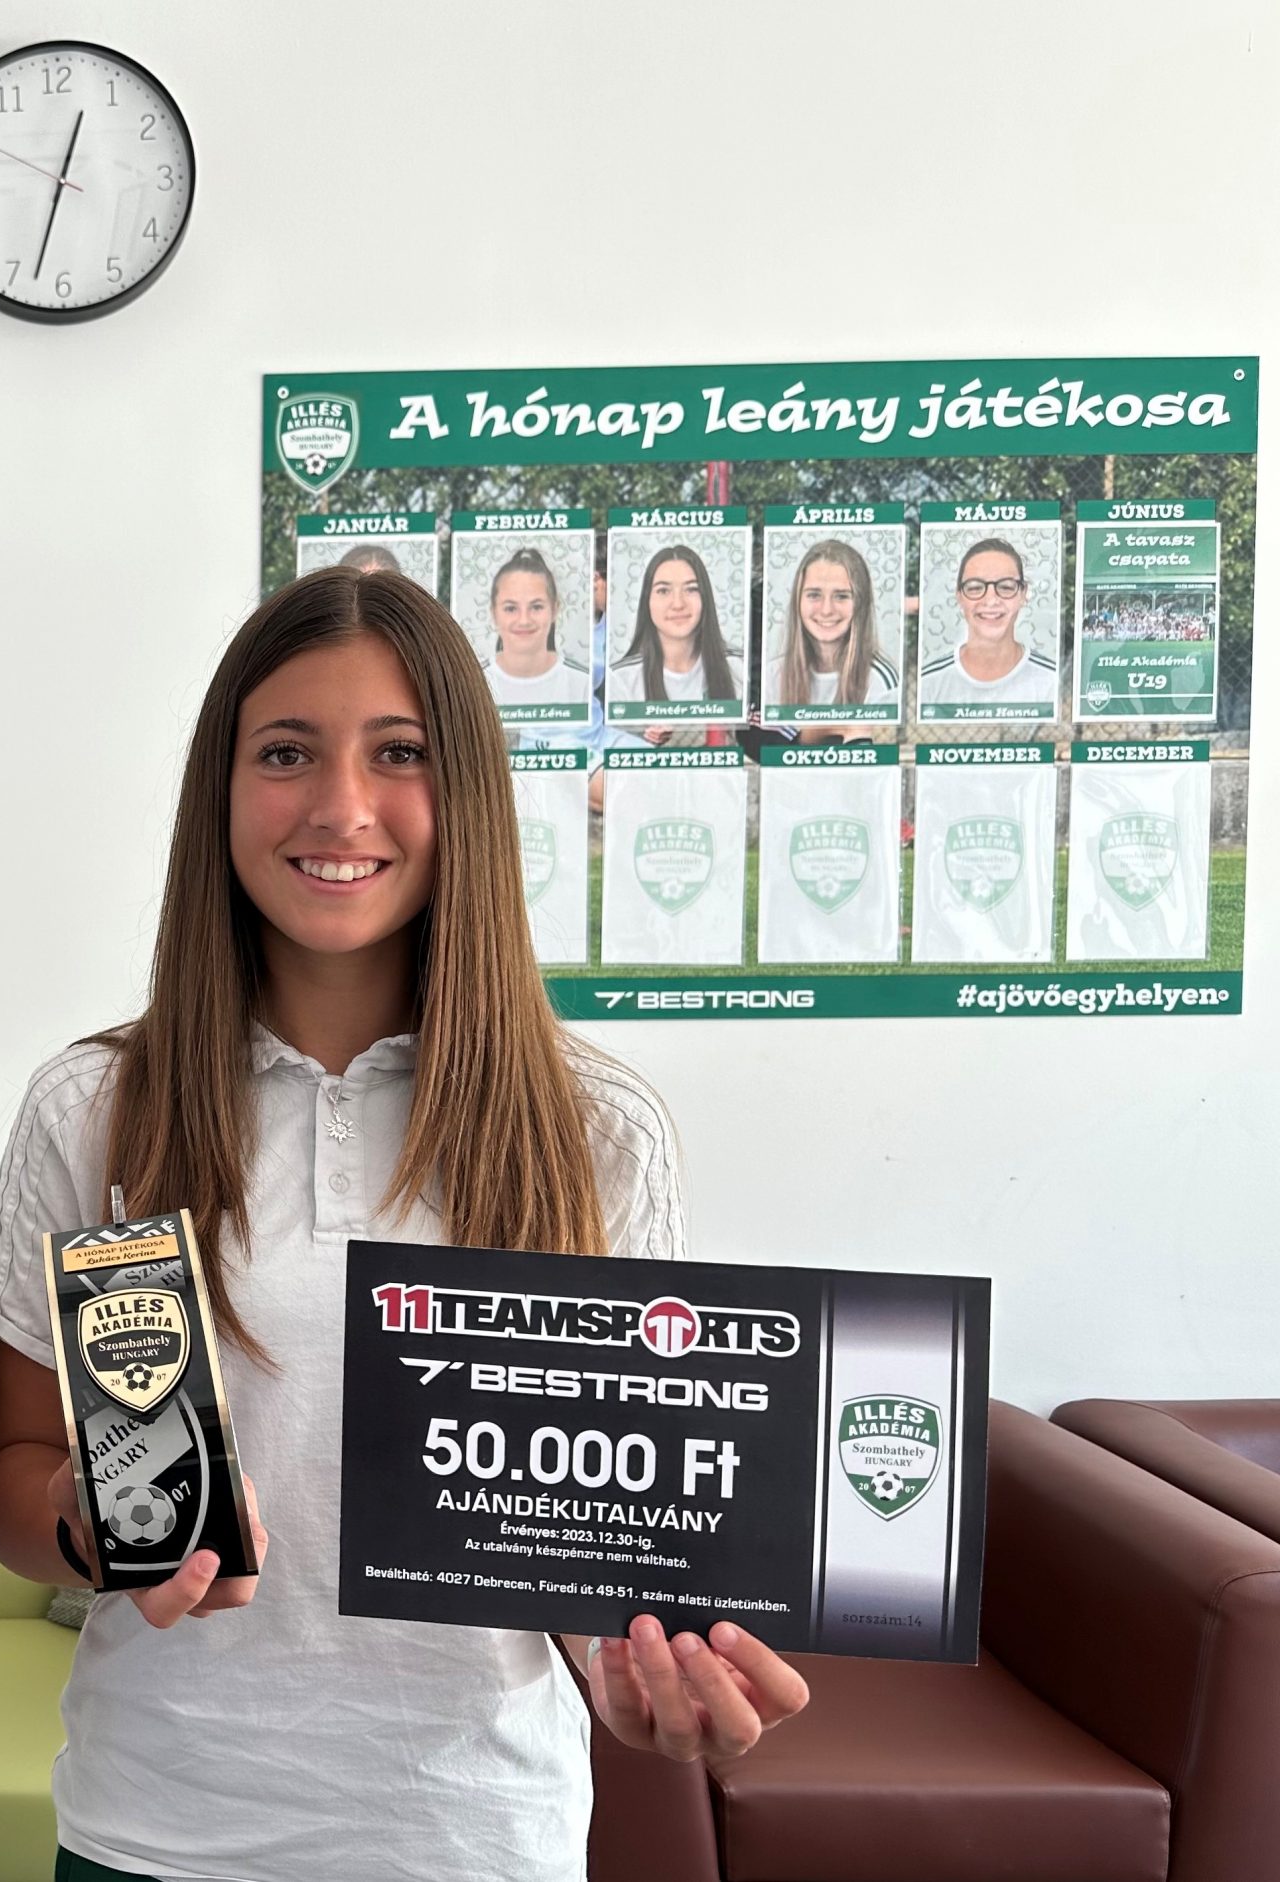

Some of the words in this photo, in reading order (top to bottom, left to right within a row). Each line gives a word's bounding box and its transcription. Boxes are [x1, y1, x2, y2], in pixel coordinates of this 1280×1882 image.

[41, 66, 72, 94] 12
[107, 80, 118, 107] 1
[140, 114, 157, 141] 2
[157, 165, 175, 192] 3
[142, 217, 160, 243] 4
[6, 261, 21, 286] 7
[107, 257, 122, 283] 5
[55, 272, 72, 298] 6
[291, 402, 343, 419] ILLÉS
[389, 395, 449, 440] A
[466, 386, 685, 450] hónap
[702, 380, 900, 444] leány
[909, 377, 1231, 438] játékosa
[631, 509, 725, 527] MÁRCIUS
[793, 506, 875, 524] ÁPRILIS
[954, 504, 1027, 522] MÁJUS
[1107, 501, 1185, 520] JÚNIUS
[323, 516, 409, 534] JANUÁR
[475, 512, 568, 530] FEBRUÁR
[1102, 533, 1122, 547] A
[1124, 533, 1196, 548] tavasz
[1108, 551, 1191, 569] csapata
[1131, 656, 1197, 667] Akadémia
[1128, 673, 1167, 689] U19
[645, 705, 688, 715] Pintér
[690, 704, 725, 715] Tekla
[608, 751, 739, 767] SZEPTEMBER
[782, 746, 877, 765] OKTÓBER
[929, 747, 1041, 763] NOVEMBER
[1087, 746, 1194, 761] DECEMBER
[637, 990, 815, 1009] BESTRONG
[956, 982, 1218, 1015] #ajövőegyhelyen
[84, 1247, 117, 1257] HÓNAP
[119, 1240, 165, 1252] JÁTÉKOSA
[95, 1296, 164, 1321] ILLÉS
[92, 1315, 173, 1336] AKADÉMIA
[98, 1335, 171, 1352] Szombathely
[112, 1348, 160, 1361] HUNGARY
[110, 1378, 120, 1386] 20
[470, 1362, 769, 1412] BESTRONG
[854, 1402, 925, 1424] ILLÉS
[848, 1421, 930, 1442] AKADÉMIA
[422, 1417, 657, 1493] 50.000
[682, 1438, 741, 1499] Ft
[852, 1442, 926, 1458] Szombathely
[864, 1456, 913, 1468] HUNGARY
[171, 1480, 191, 1502] 07
[858, 1482, 870, 1491] 20
[904, 1485, 916, 1494] 07
[435, 1488, 723, 1534] AJÁNDÉKUTALVÁNY
[500, 1521, 560, 1542] Érvényes:
[561, 1528, 656, 1551] 2023.12.30-ig.
[464, 1538, 481, 1551] Az
[483, 1540, 534, 1557] utalvány
[535, 1543, 604, 1561] készpénzre
[606, 1551, 633, 1563] nem
[635, 1551, 691, 1569] váltható.
[365, 1565, 433, 1583] Beváltható:
[436, 1571, 471, 1585] 4027
[473, 1574, 536, 1593] Debrecen,
[538, 1579, 578, 1595] Füredi
[580, 1582, 594, 1596] út
[596, 1584, 639, 1600] 49-51.
[641, 1589, 675, 1603] szám
[677, 1592, 711, 1607] alatti
[714, 1595, 791, 1613] üzletünkben.
[842, 1612, 923, 1627] sorszám:14
